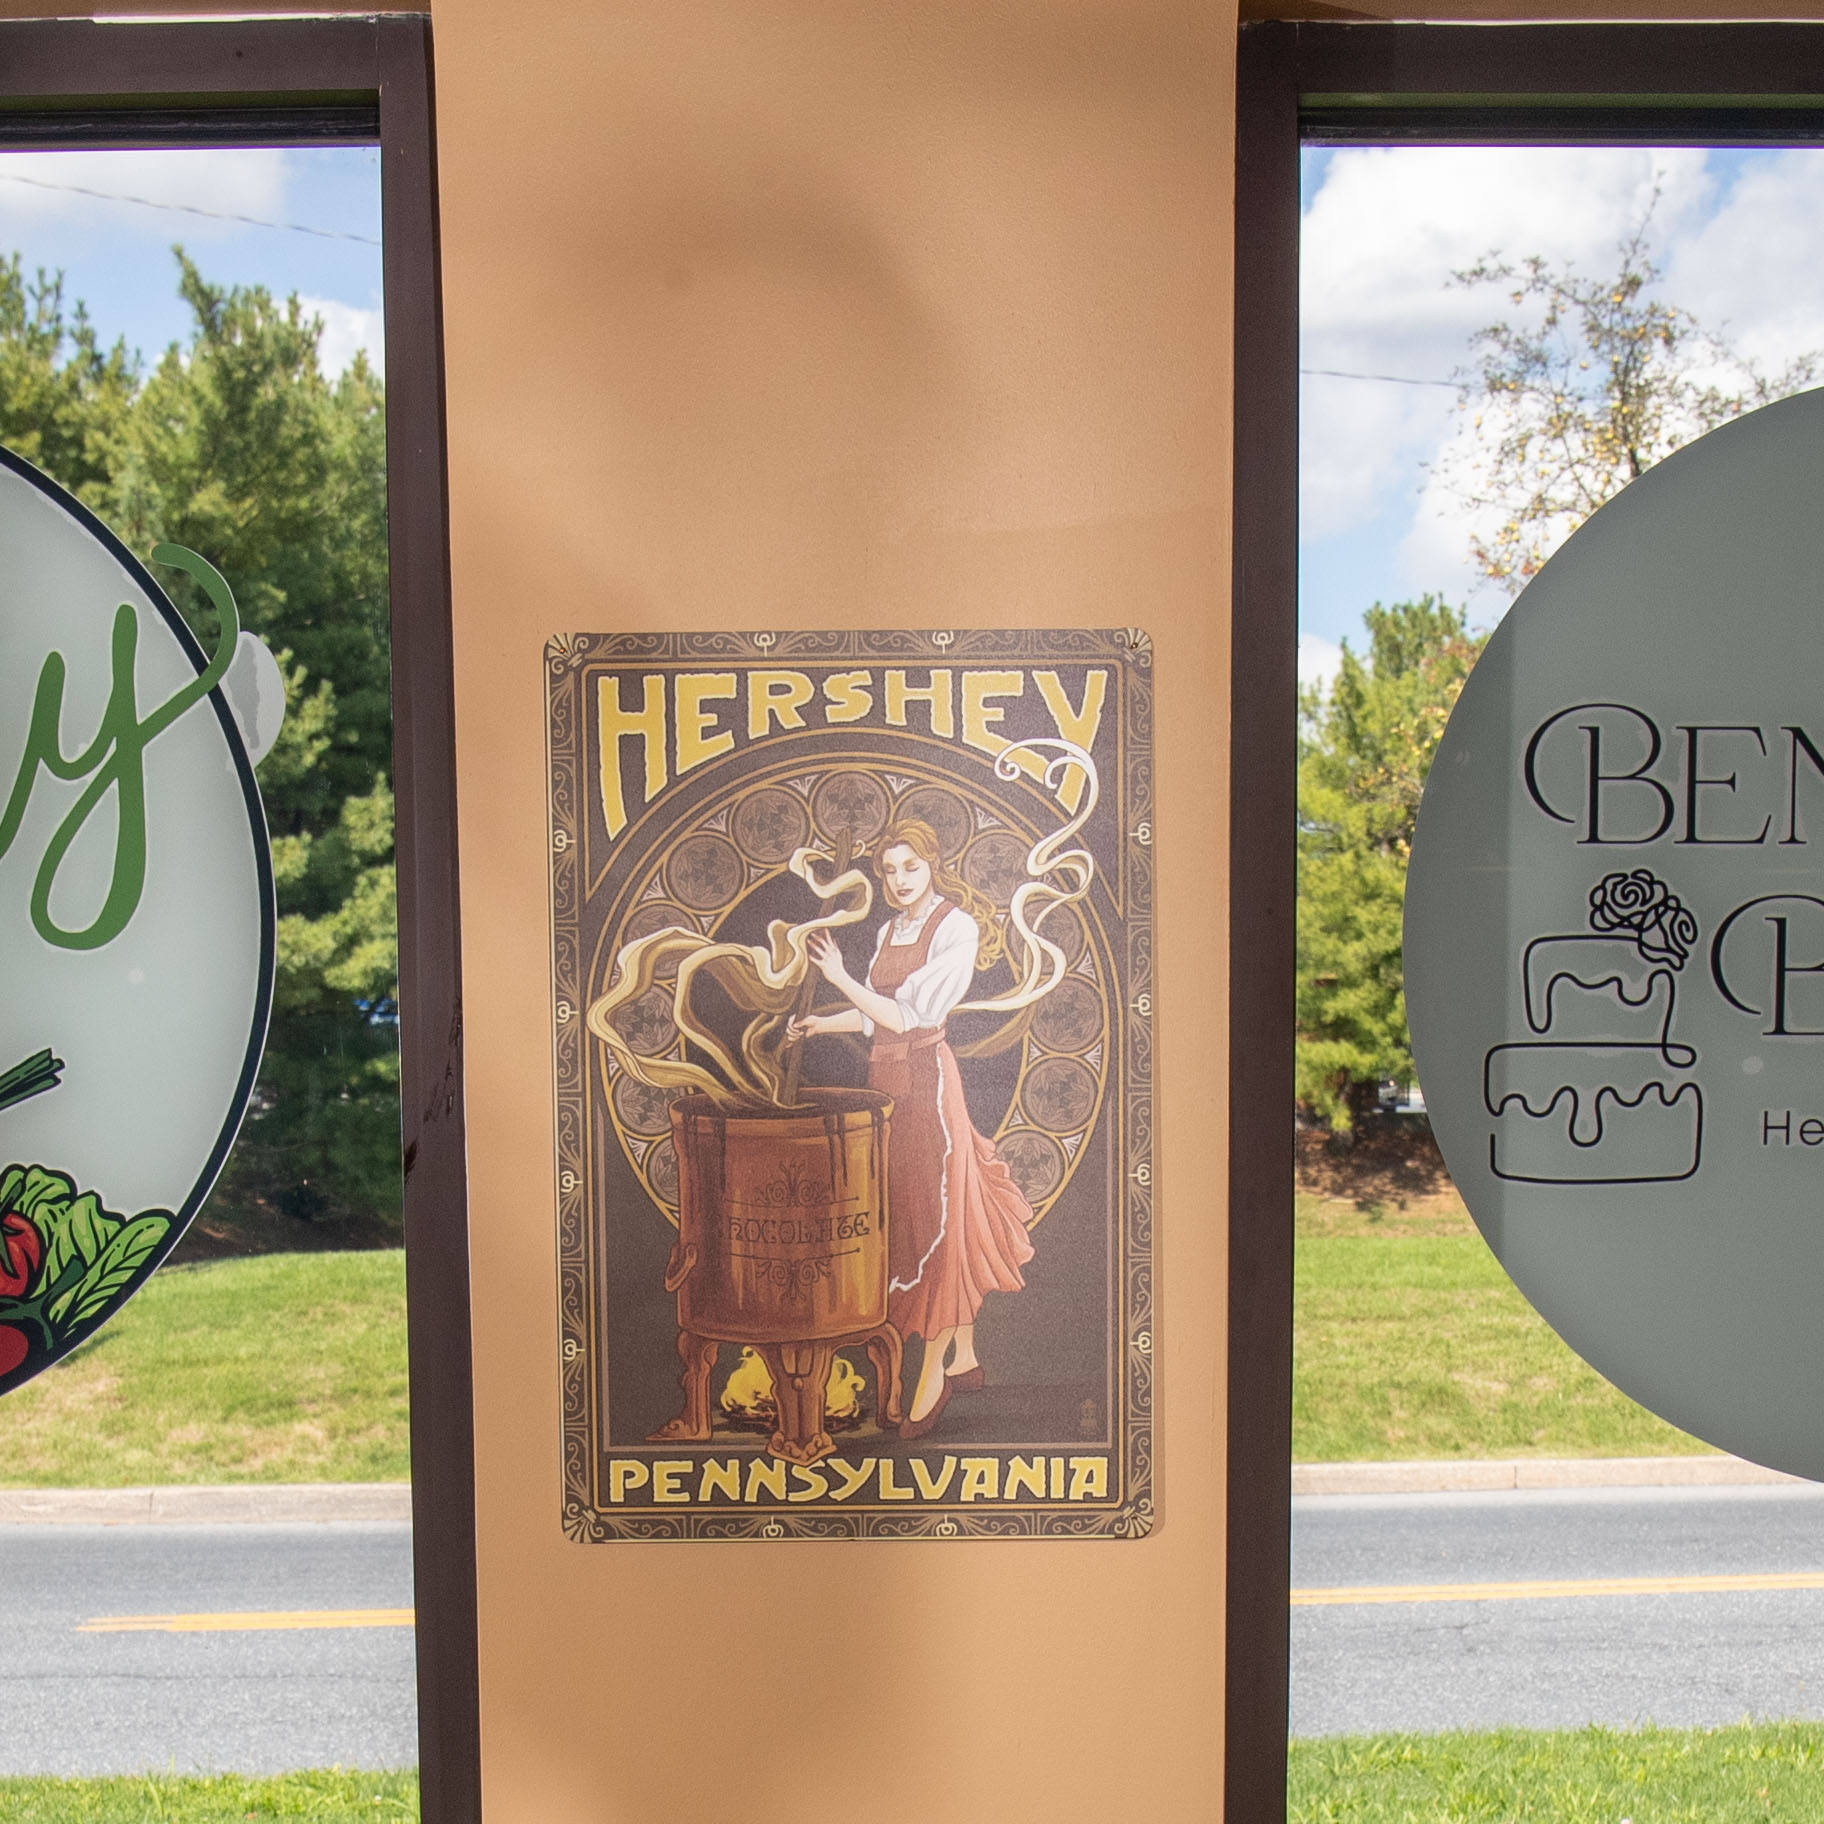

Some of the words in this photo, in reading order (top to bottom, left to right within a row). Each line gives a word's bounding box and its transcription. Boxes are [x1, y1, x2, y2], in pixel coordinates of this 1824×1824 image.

[597, 669, 1109, 842] HERSHEY
[716, 1212, 871, 1244] HOCOLATE
[608, 1454, 1109, 1503] PENNSYLVANIA
